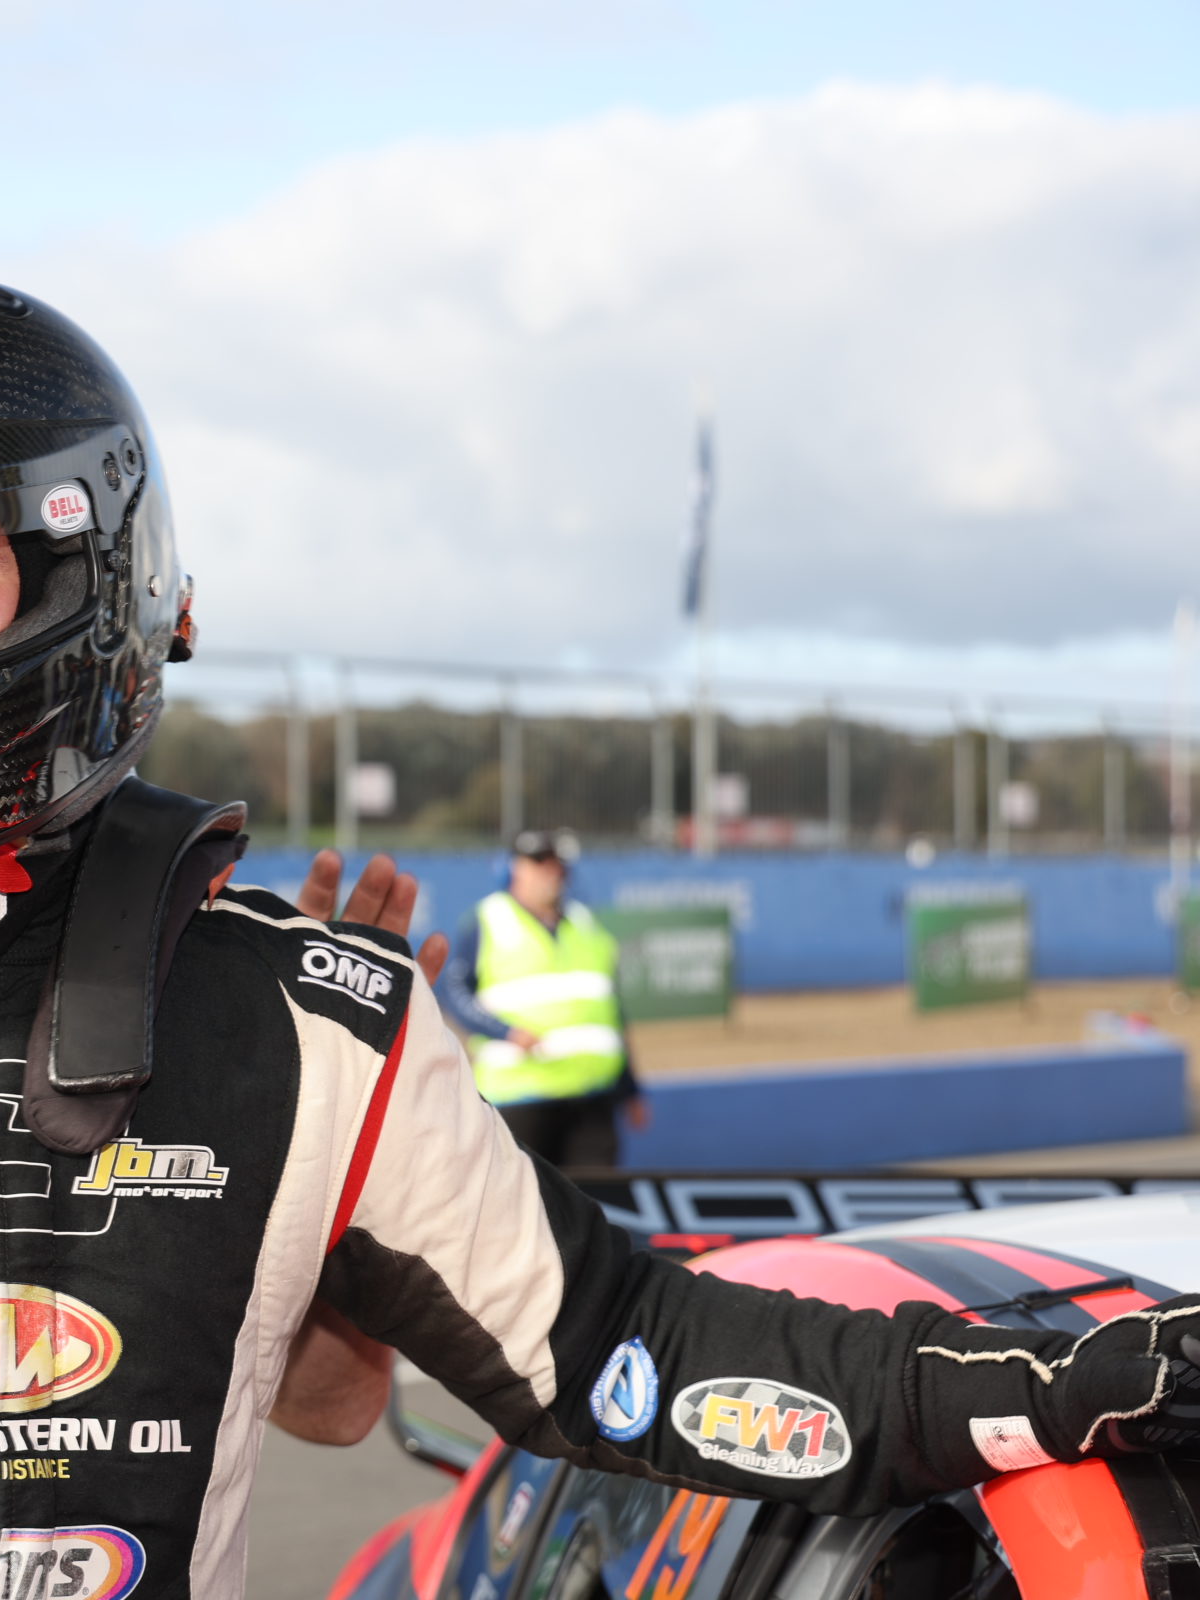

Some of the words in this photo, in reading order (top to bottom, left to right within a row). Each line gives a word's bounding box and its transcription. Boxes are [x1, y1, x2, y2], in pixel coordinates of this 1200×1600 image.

[48, 494, 86, 519] BELL
[301, 947, 392, 999] OMP
[113, 1186, 223, 1200] motorsport
[129, 1419, 192, 1453] OIL
[700, 1393, 830, 1459] FW1
[698, 1442, 782, 1473] Cleaning
[782, 1456, 825, 1478] Wax
